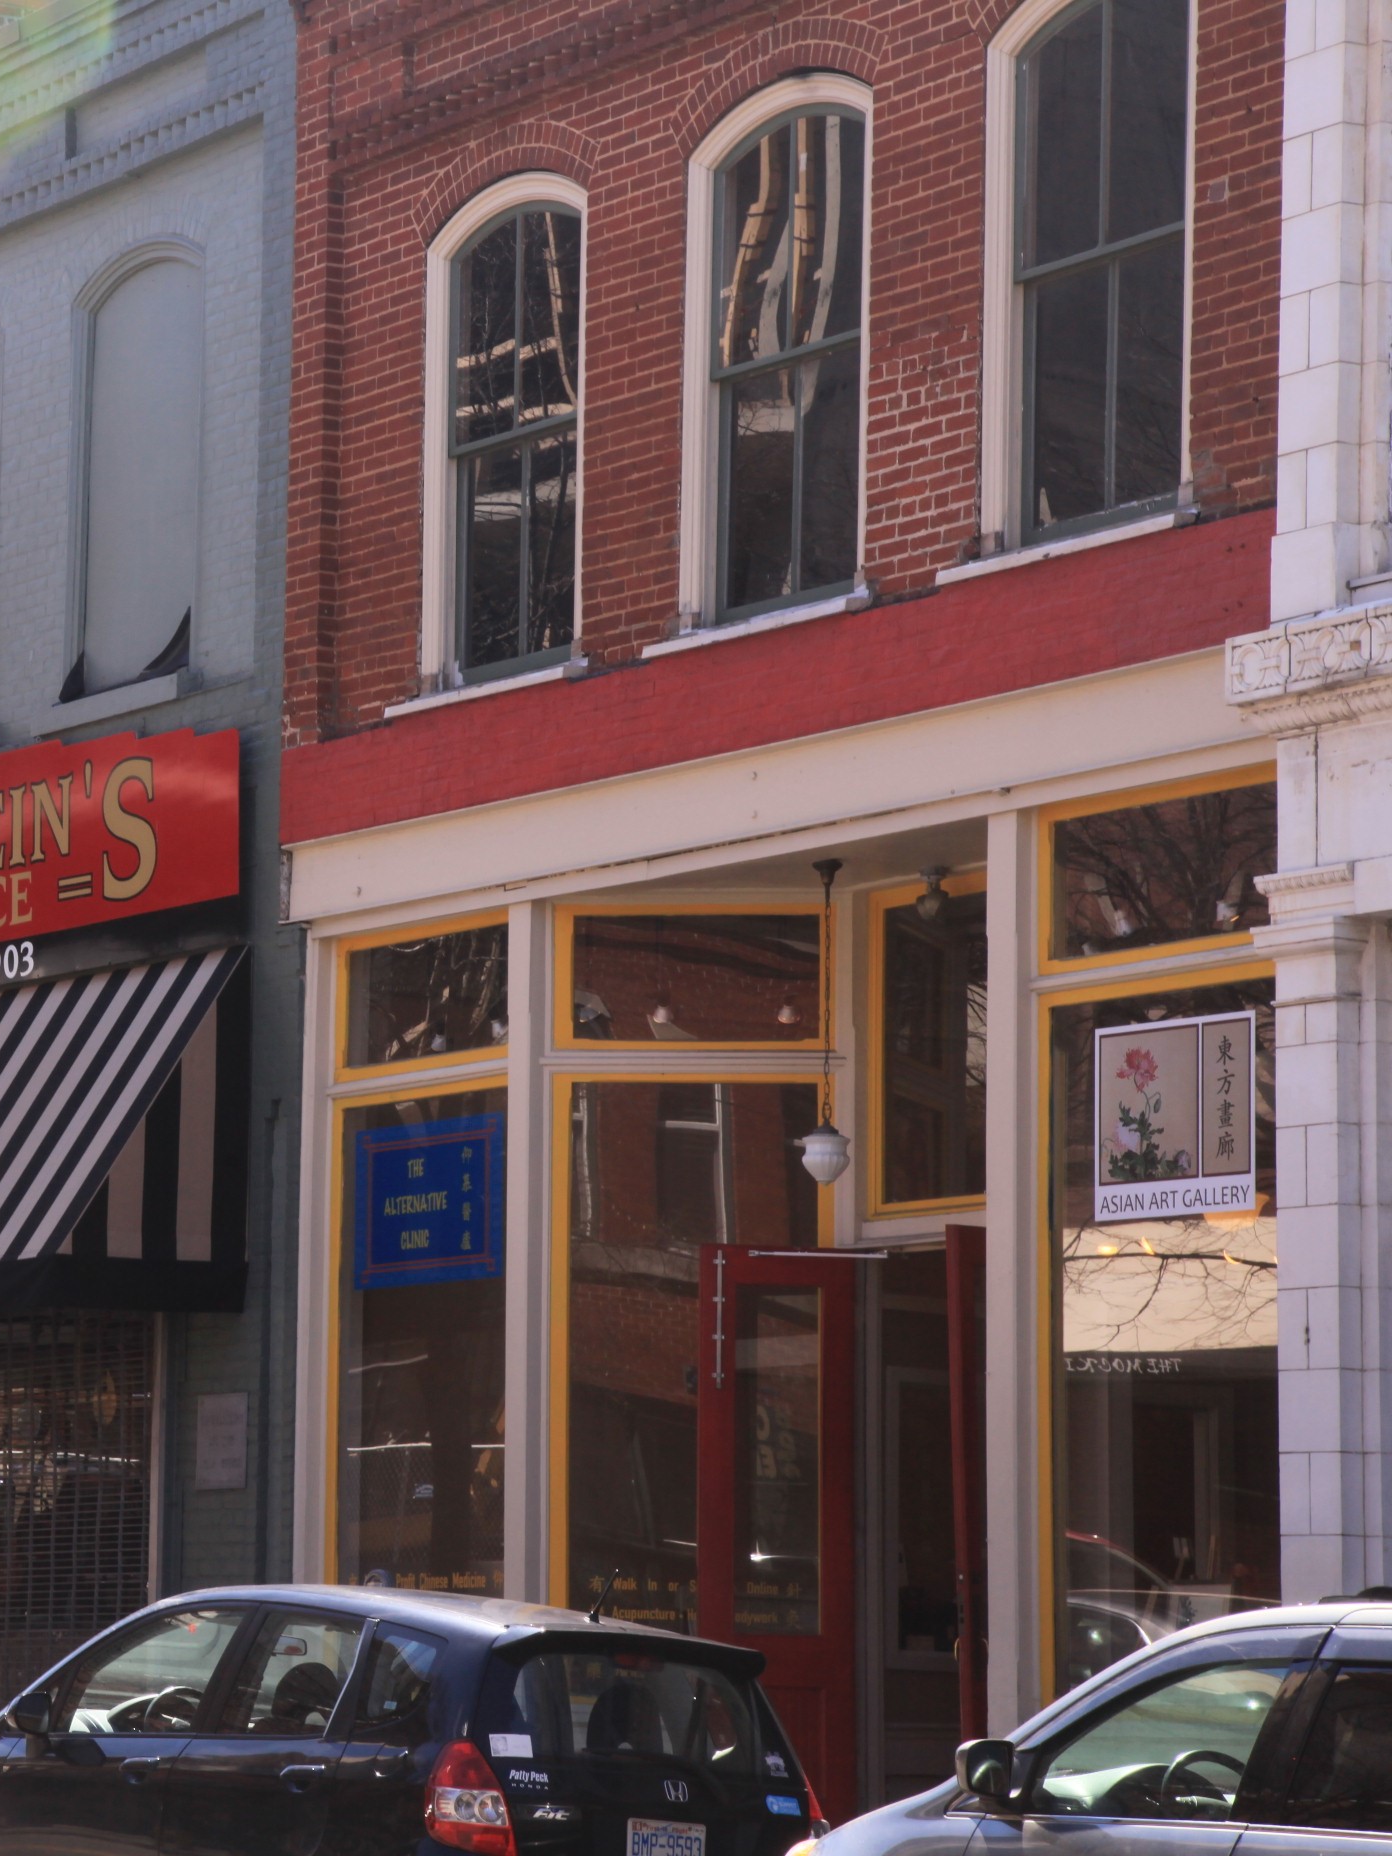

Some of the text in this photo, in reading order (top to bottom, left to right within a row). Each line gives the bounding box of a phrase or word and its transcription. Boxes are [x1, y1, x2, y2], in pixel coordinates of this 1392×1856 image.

[1215, 1035, 1236, 1161] 東方畫廊
[408, 1158, 425, 1178] THE
[383, 1191, 448, 1216] ALTERNATIVE
[1100, 1184, 1250, 1215] ASIAN ART GALLERY
[400, 1229, 430, 1250] CLINIC
[419, 1572, 448, 1589] Chinese
[452, 1571, 486, 1588] Medicine
[613, 1577, 637, 1591] Walk
[648, 1578, 657, 1591] In
[668, 1581, 679, 1591] or
[746, 1580, 779, 1596] Online
[612, 1605, 675, 1622] Acupuncture
[735, 1611, 779, 1626] odywork
[509, 1769, 549, 1783] Patty Peck
